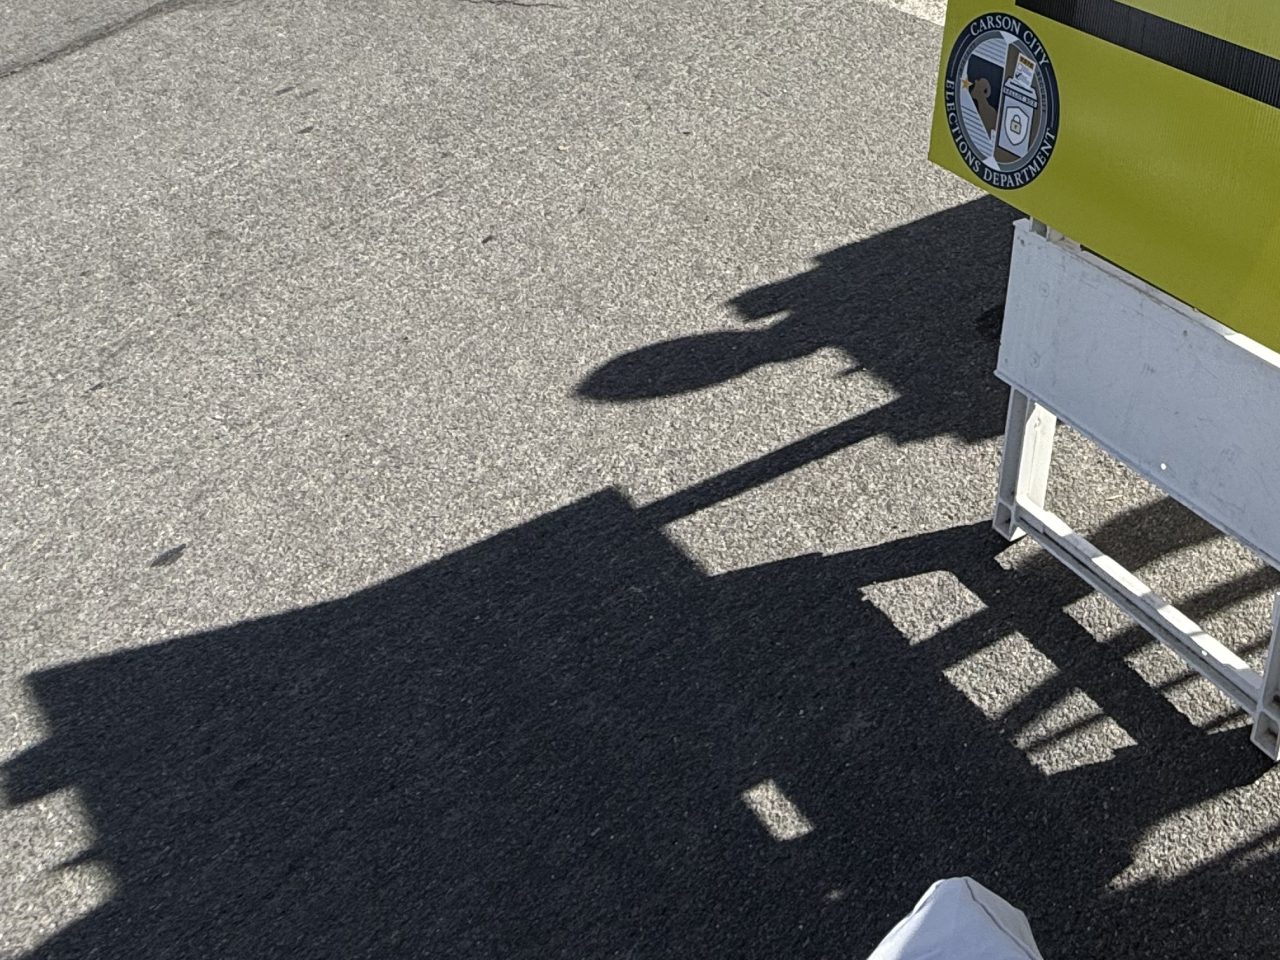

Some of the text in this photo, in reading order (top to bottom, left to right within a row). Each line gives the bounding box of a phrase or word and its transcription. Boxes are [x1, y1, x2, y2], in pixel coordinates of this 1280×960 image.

[970, 14, 1050, 66] CARSON CITY
[946, 79, 1056, 187] ELECTIONS DEPARTMENT
